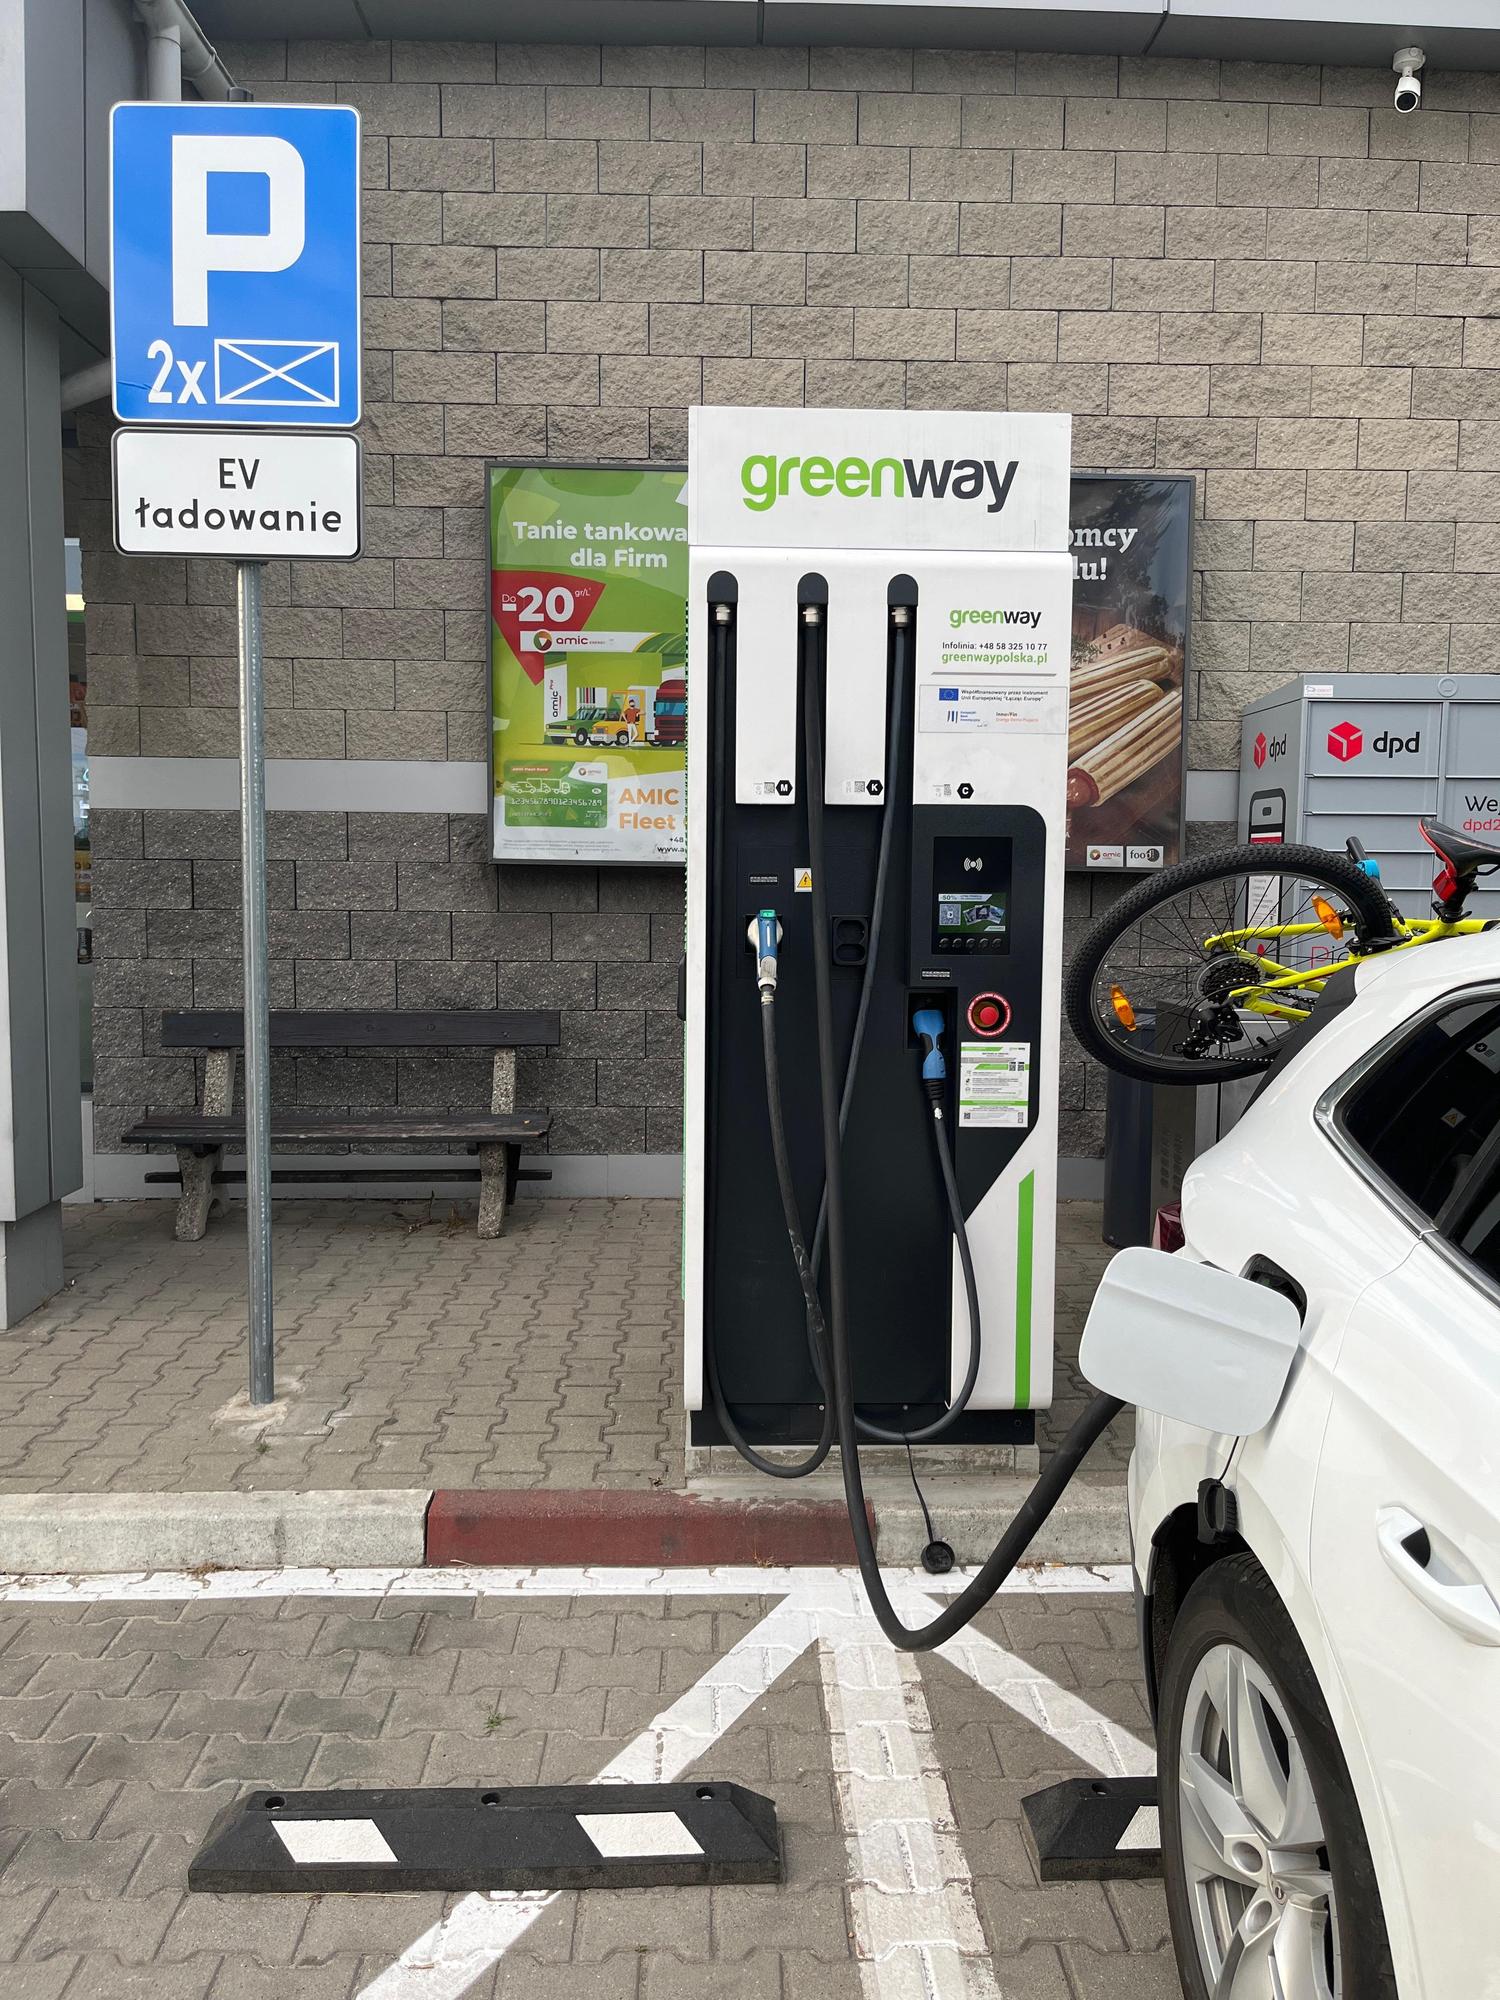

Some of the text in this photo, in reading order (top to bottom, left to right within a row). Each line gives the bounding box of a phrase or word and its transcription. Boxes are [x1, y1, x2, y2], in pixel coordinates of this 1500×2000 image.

[172, 135, 305, 326] P
[147, 340, 207, 404] 2x
[218, 458, 260, 490] EV
[741, 455, 1019, 513] greenway
[135, 497, 342, 533] ładowanie
[512, 519, 688, 542] Tanie tankowa
[570, 548, 668, 568] dla Firm
[502, 594, 517, 603] Do
[950, 609, 1041, 629] greenway
[556, 635, 589, 645] amic
[942, 641, 977, 650] Infolinia:
[942, 652, 1048, 665] greenwaypolska.pl
[1269, 733, 1287, 763] dpd
[1372, 731, 1421, 759] dpd
[618, 788, 680, 806] AMIC
[1464, 795, 1500, 816] We
[618, 812, 676, 831] Fleet
[1463, 818, 1500, 833] dpd2
